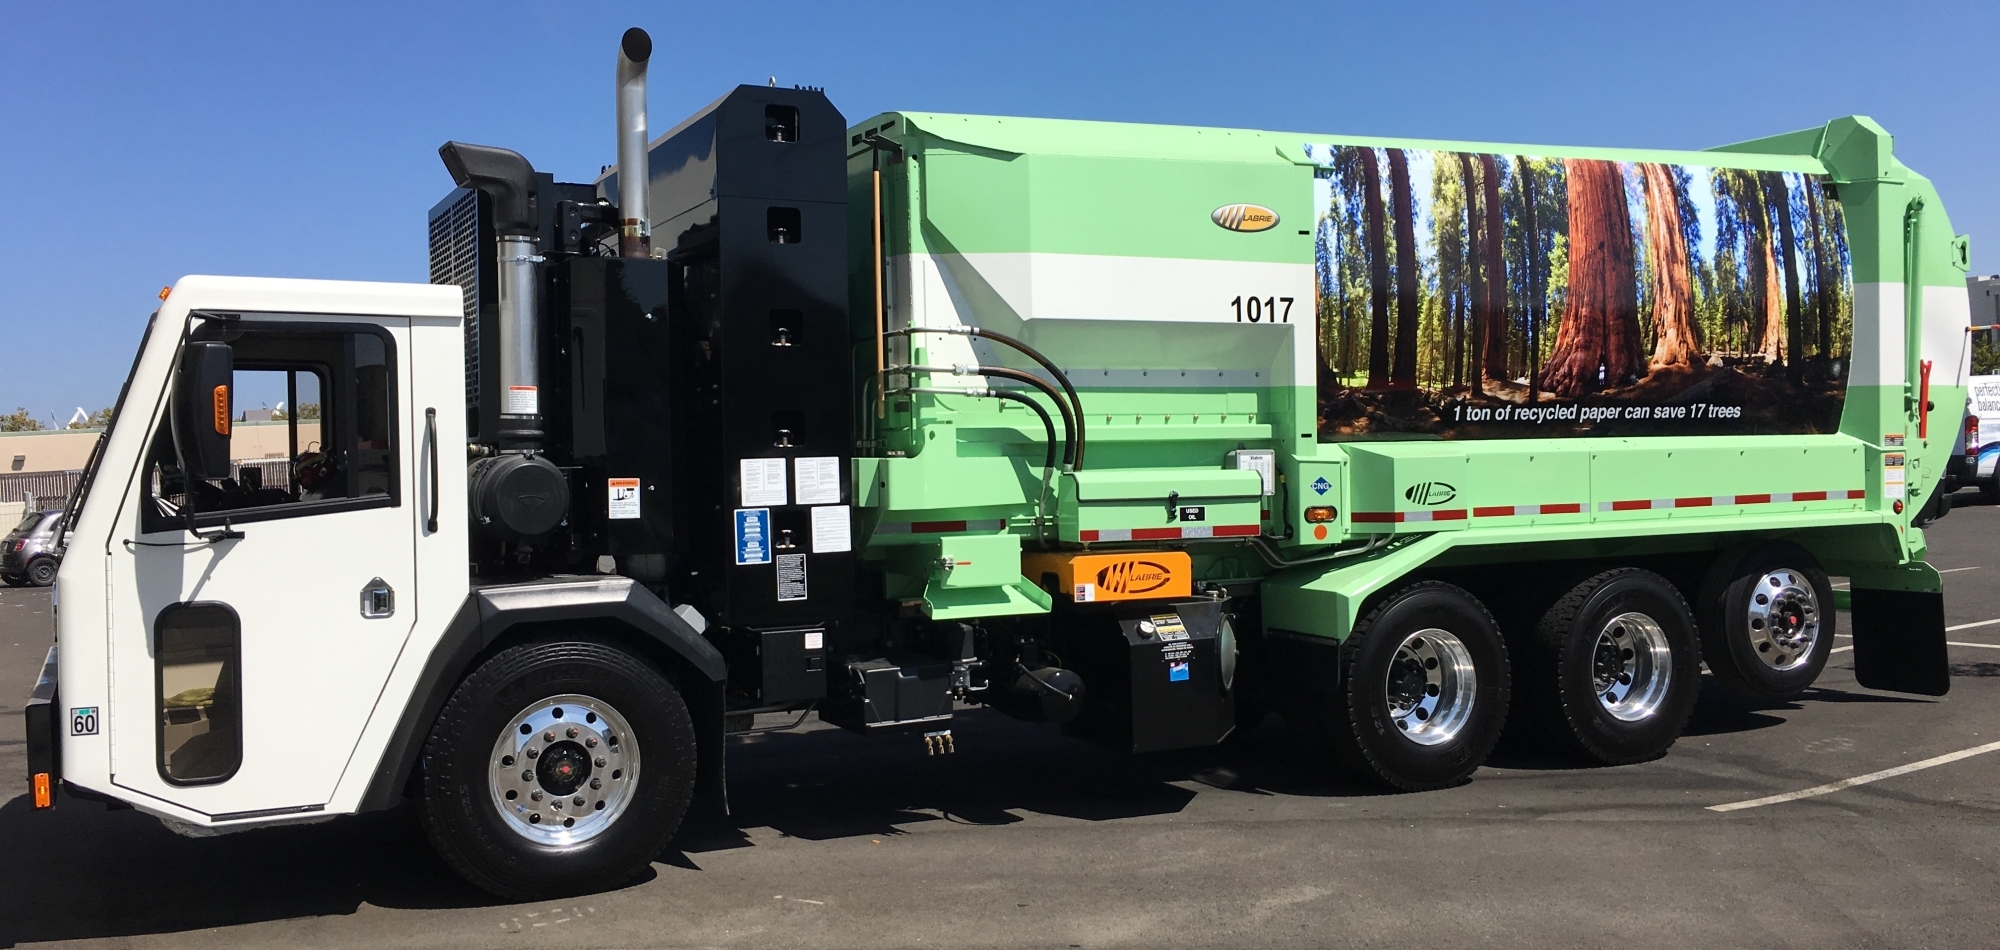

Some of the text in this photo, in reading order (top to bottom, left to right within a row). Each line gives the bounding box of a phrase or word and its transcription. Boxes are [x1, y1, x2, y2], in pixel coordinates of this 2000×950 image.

[1242, 214, 1273, 223] LABRIE
[1231, 295, 1295, 323] 1017
[1453, 403, 1742, 424] 1 ton of recycled paper can save 17 trees
[1312, 482, 1330, 490] CNG
[1130, 572, 1164, 582] LABRIE
[74, 714, 95, 733] 60
